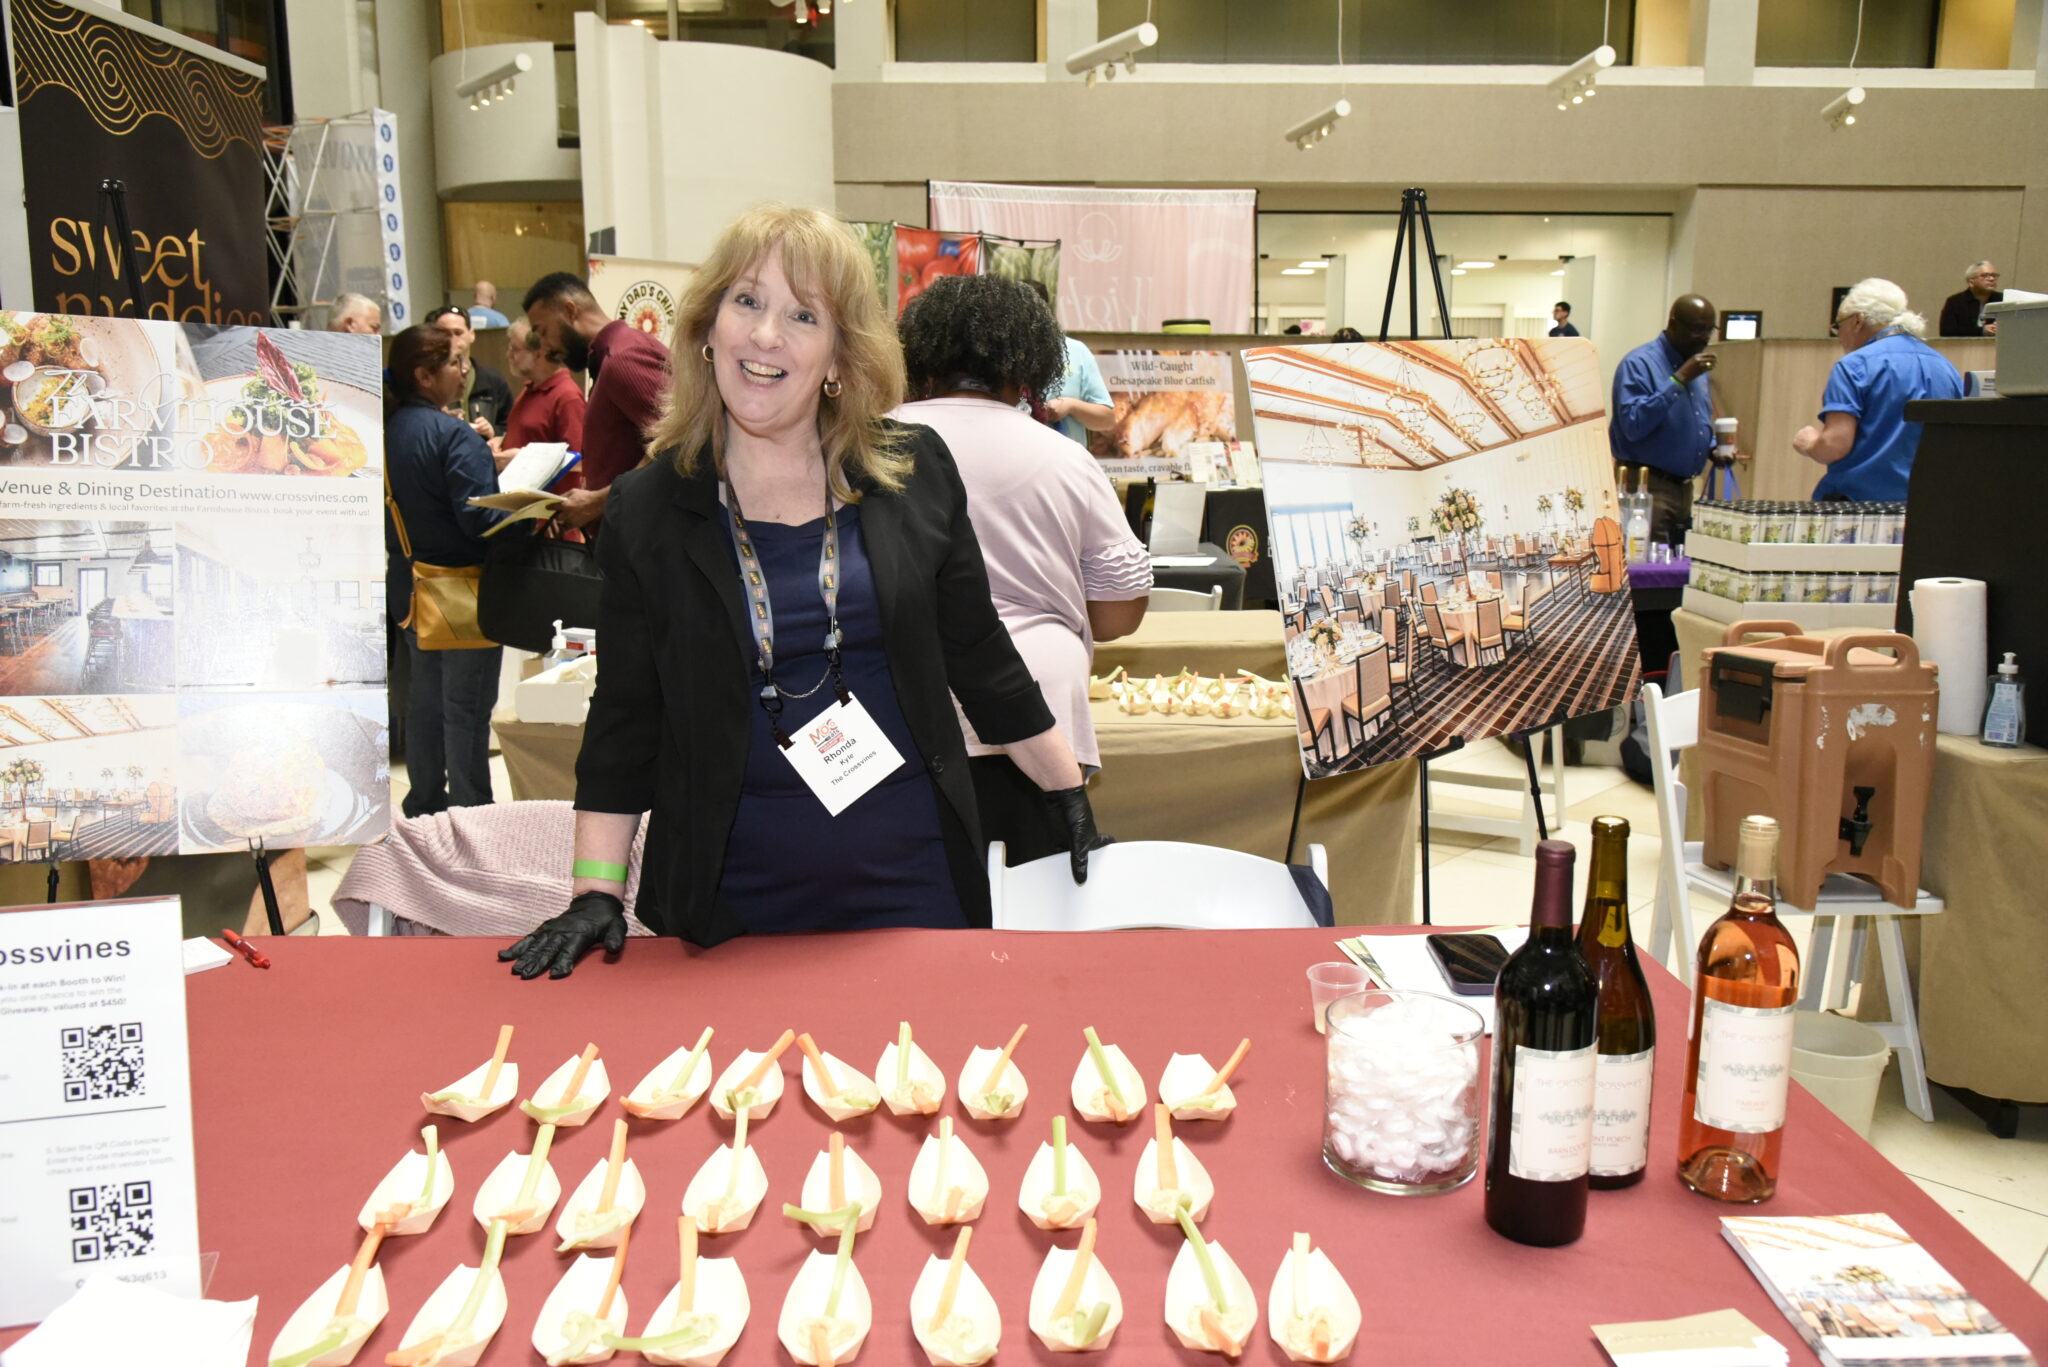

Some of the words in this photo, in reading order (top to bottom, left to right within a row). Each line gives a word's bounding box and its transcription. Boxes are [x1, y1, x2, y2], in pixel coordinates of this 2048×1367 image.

[50, 217, 210, 288] sweet
[619, 302, 629, 321] MY
[626, 283, 655, 305] DAD'S
[1109, 376, 1162, 387] Chesapeake
[1163, 376, 1183, 386] Blue
[1184, 376, 1216, 386] Catfish
[48, 396, 338, 439] FARMHOUSE
[48, 432, 215, 470] BISTRO
[1124, 466, 1147, 474] taste,
[1148, 464, 1182, 473] cravable
[58, 481, 72, 496] &
[78, 482, 134, 502] Dining
[139, 484, 237, 501] Destination
[240, 492, 368, 504] www.crossvines.com
[49, 502, 97, 512] ingredients
[110, 502, 129, 512] local
[131, 503, 169, 513] favorites
[181, 505, 195, 514] the
[196, 505, 243, 515] Farmhouse
[295, 508, 314, 518] your
[315, 508, 337, 517] event
[339, 507, 358, 517] with
[823, 738, 857, 765] Rhonda
[839, 753, 854, 765] Kyle
[831, 775, 844, 786] The
[842, 751, 876, 776] Crossvines
[32, 979, 57, 989] each
[59, 977, 88, 987] Booth
[91, 976, 102, 984] to
[103, 973, 127, 984] Win!
[53, 1002, 87, 1011] valued
[109, 1139, 132, 1149] Code
[86, 1153, 110, 1162] Code
